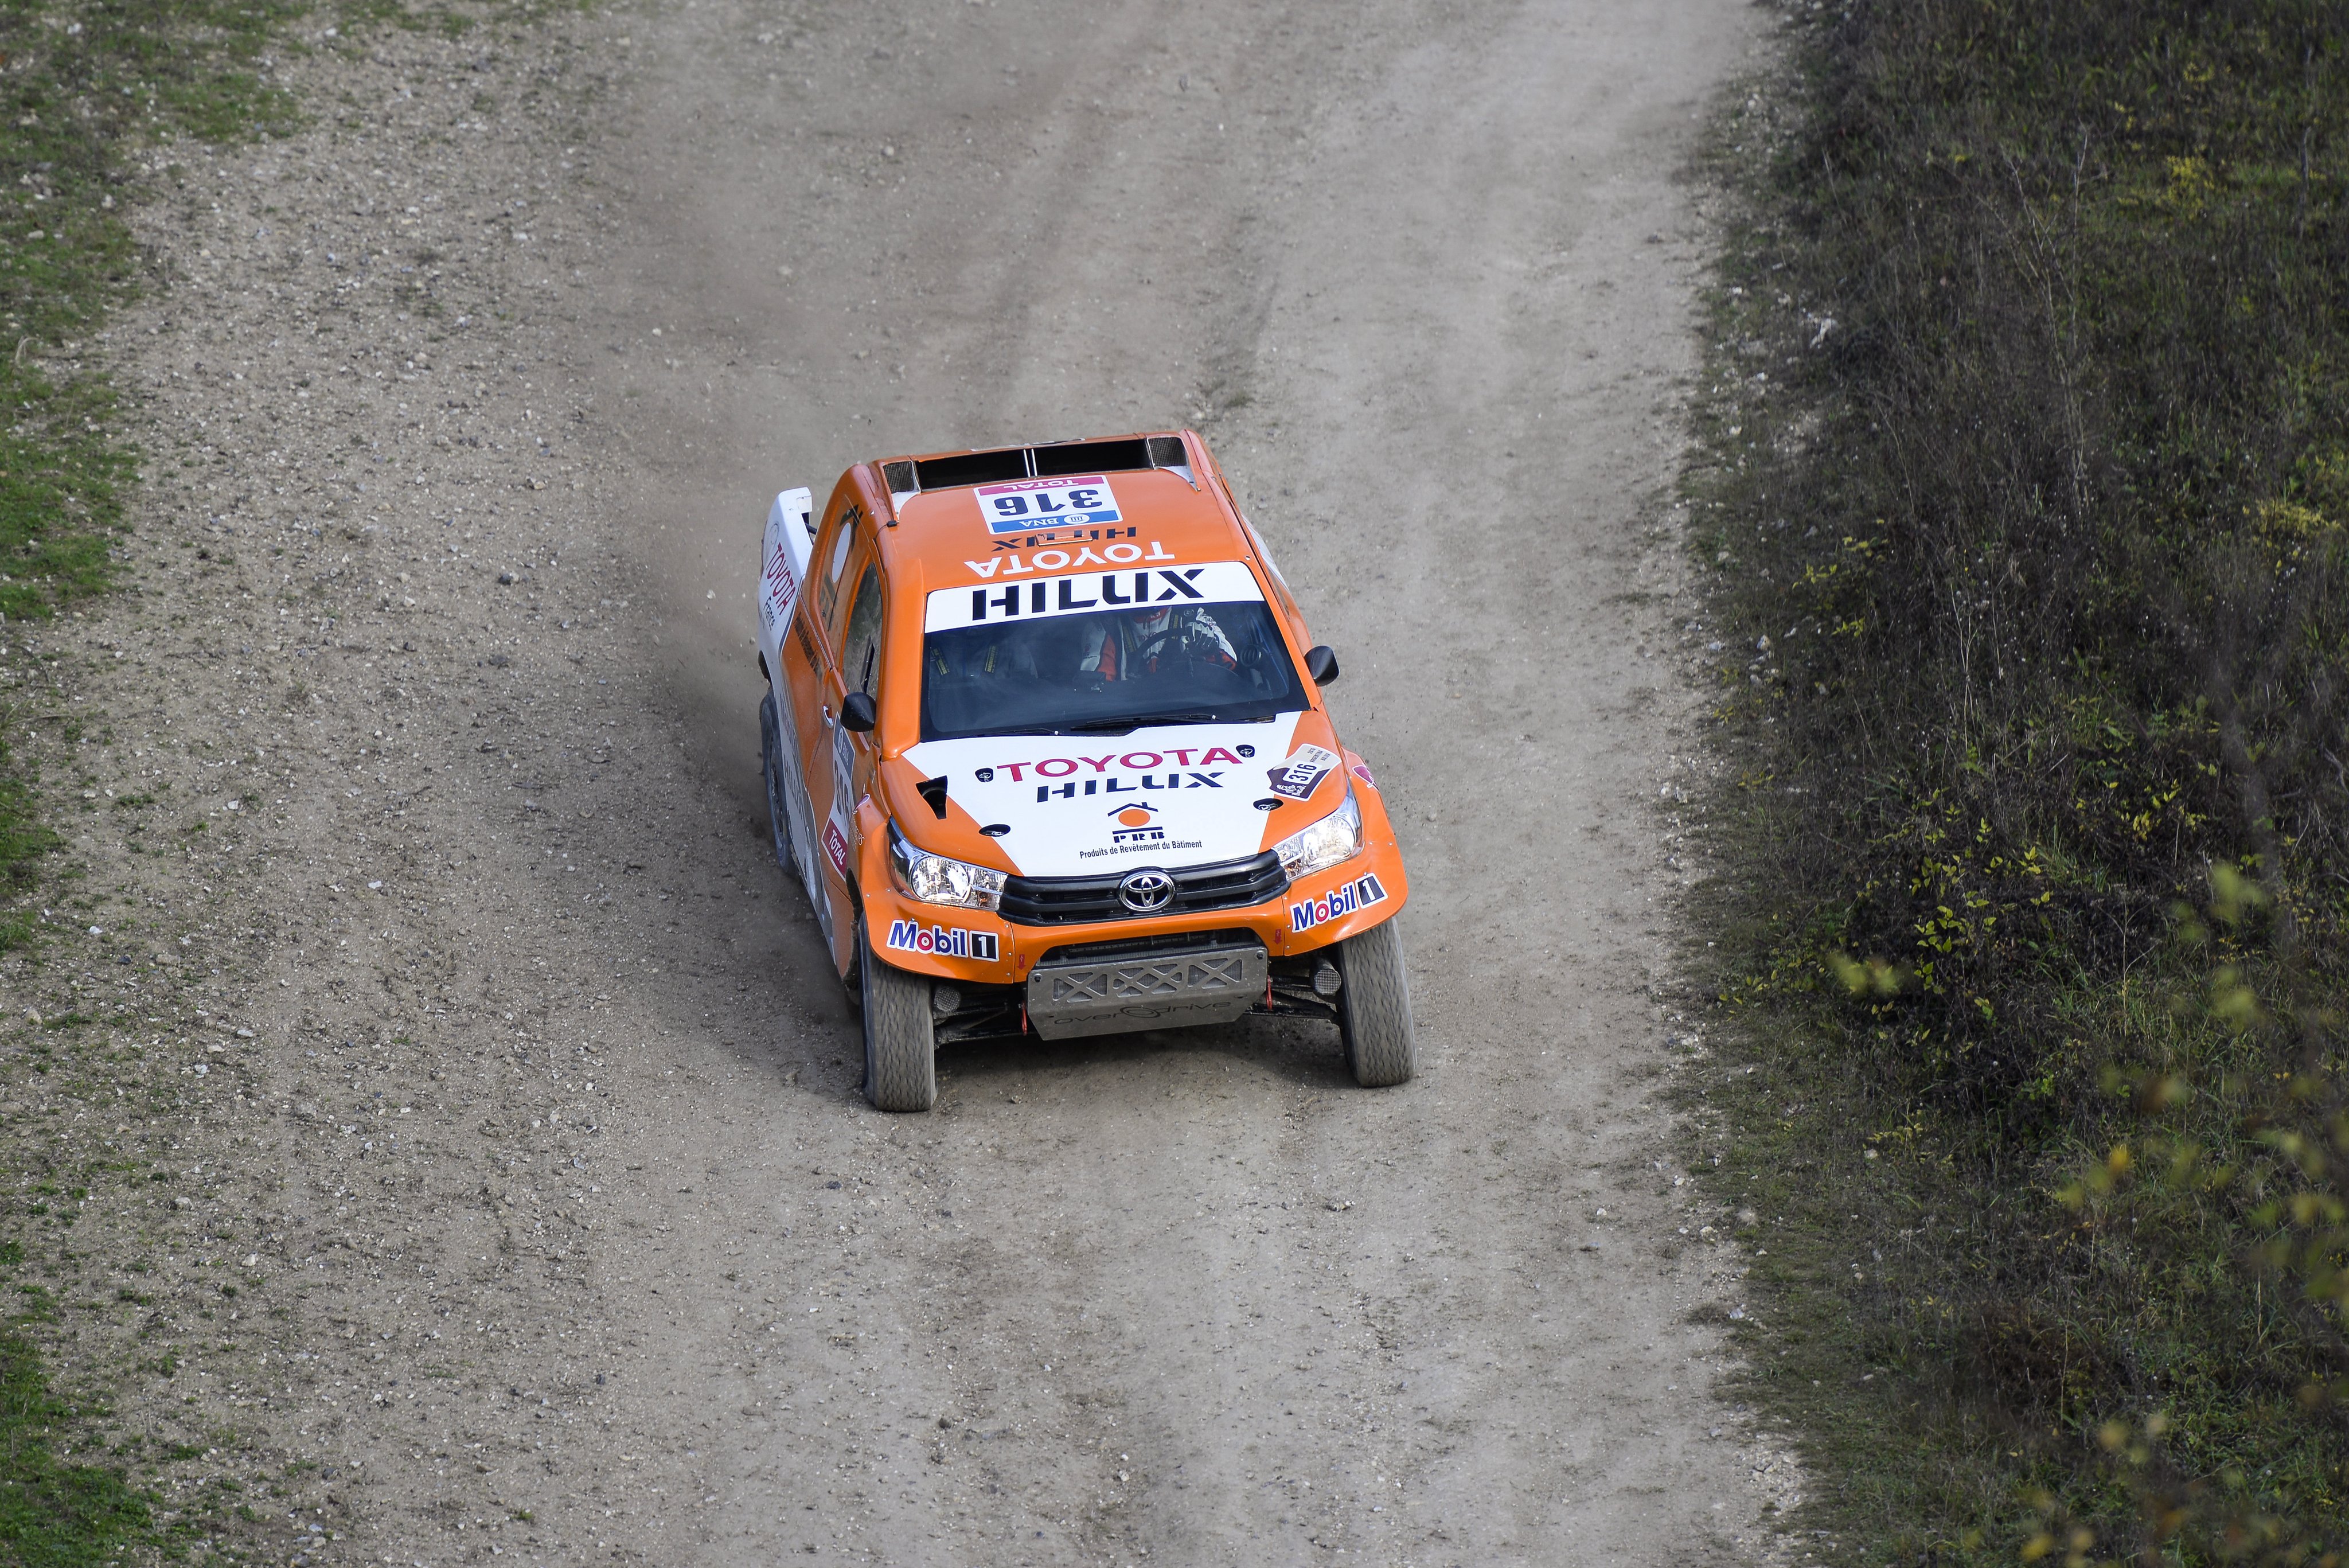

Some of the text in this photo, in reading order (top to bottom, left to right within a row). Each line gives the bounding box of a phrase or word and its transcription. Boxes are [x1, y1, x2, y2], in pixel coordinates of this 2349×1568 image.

[993, 489, 1103, 516] 316
[1003, 479, 1079, 491] TOTAL
[1019, 517, 1060, 528] BNA
[963, 541, 1176, 578] TOYOTA
[765, 542, 797, 615] TOYOTA
[972, 568, 1205, 621] HILUX
[763, 595, 776, 631] France
[996, 747, 1244, 782] TOYOTA
[1288, 763, 1317, 782] 316
[1037, 772, 1226, 803] HILUX
[829, 829, 846, 866] TOTAL
[1079, 840, 1203, 859] Produits de Revêtement du Bâtiment
[1113, 832, 1165, 844] PRB
[1292, 884, 1357, 932] Mobil
[888, 921, 967, 957] Mobil
